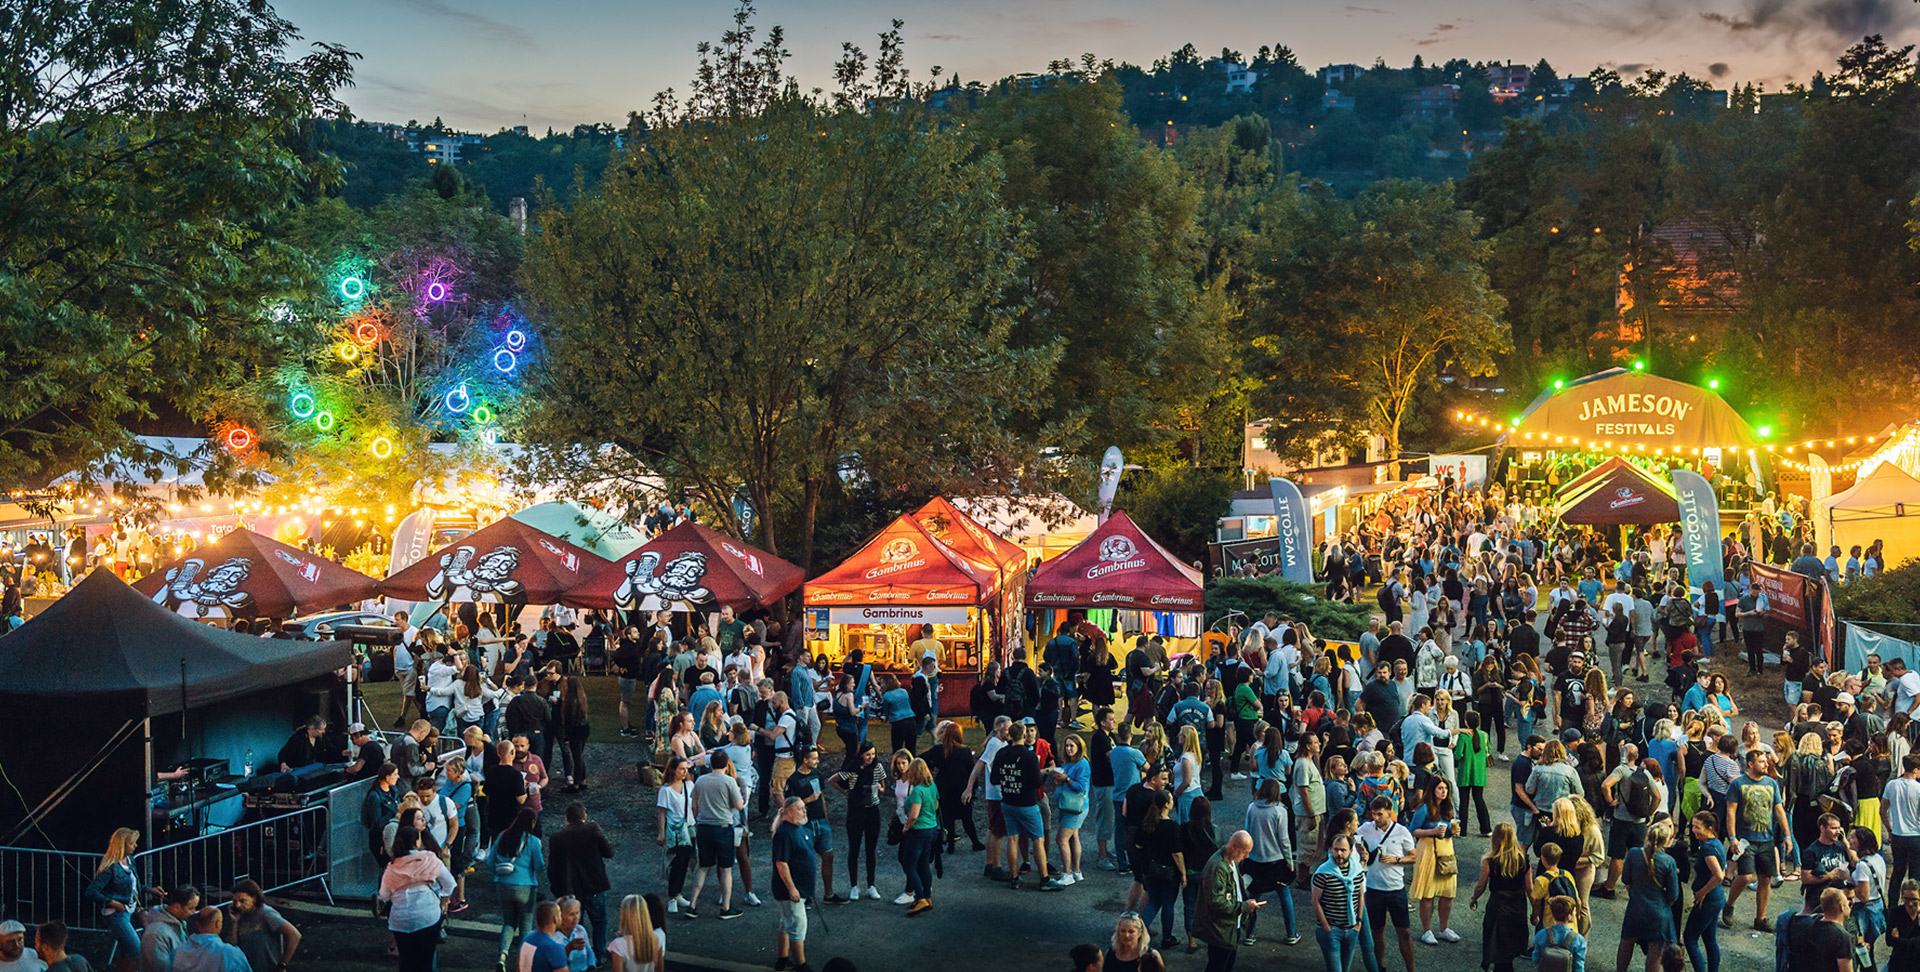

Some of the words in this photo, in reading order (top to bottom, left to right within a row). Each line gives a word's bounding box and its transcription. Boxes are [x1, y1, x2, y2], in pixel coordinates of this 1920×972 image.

[1578, 393, 1689, 421] JAMESON
[1596, 423, 1675, 435] FESTIVALS
[1435, 465, 1455, 476] WC
[409, 527, 426, 566] COTTE
[865, 557, 926, 579] Gambrinus
[1086, 558, 1146, 580] Gambrinus
[811, 590, 853, 602] Gambrinus
[868, 589, 911, 600] Gambrinus
[926, 589, 969, 600] Gambrinus
[1033, 591, 1076, 602] Gambrinus
[1091, 592, 1135, 603] Gambrinus
[1150, 594, 1193, 605] Gambrinus
[862, 608, 924, 619] Gambrinus
